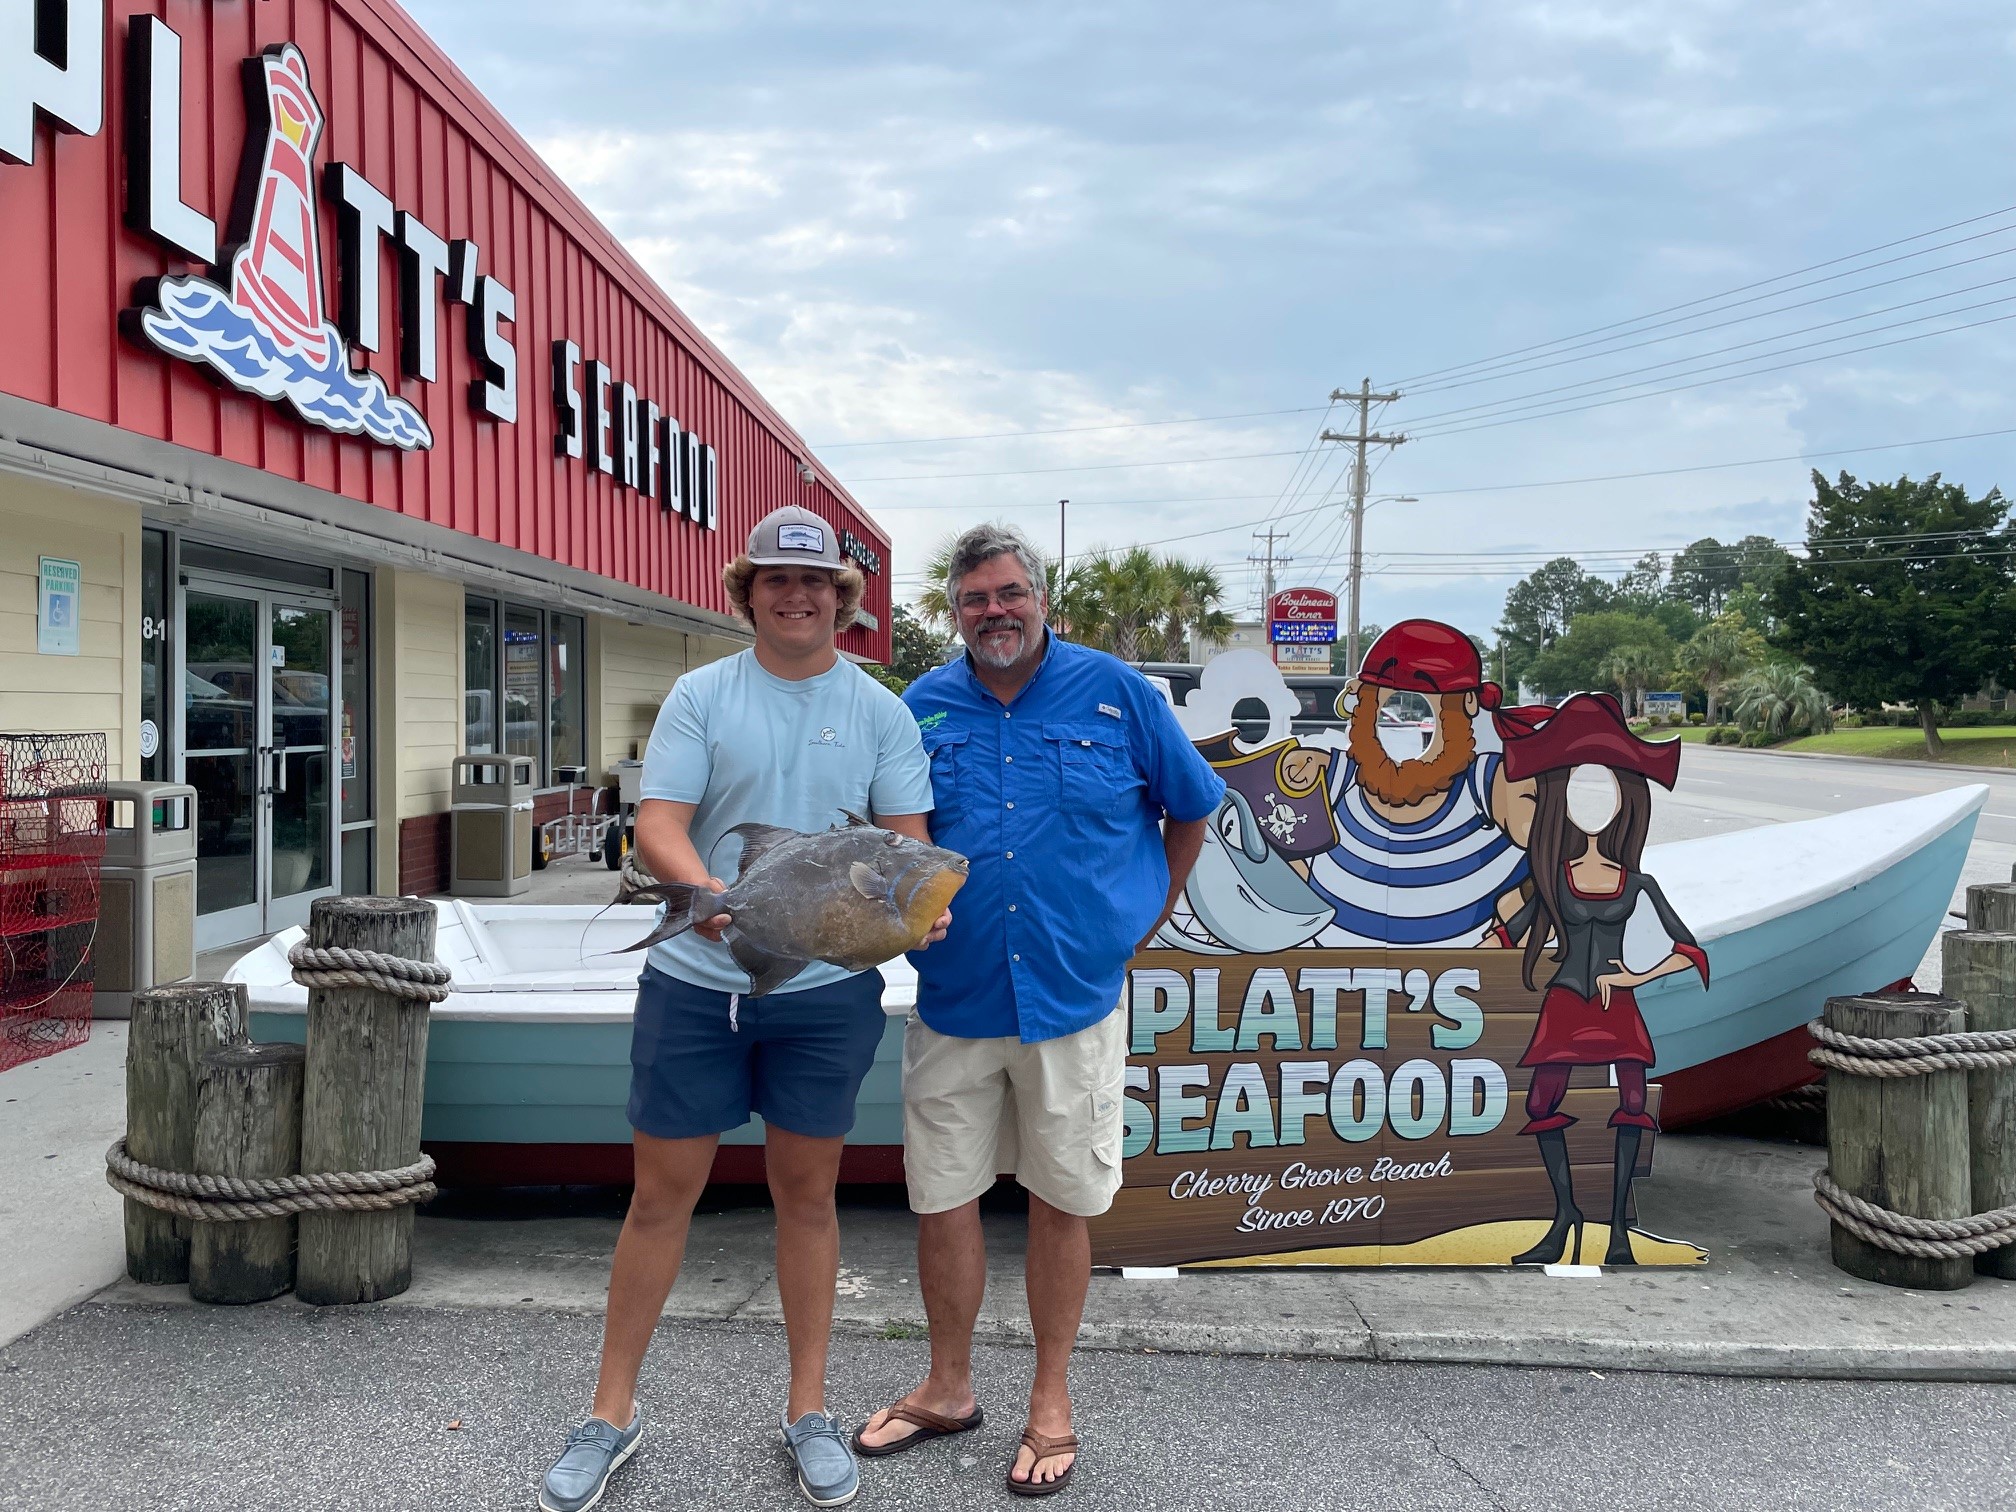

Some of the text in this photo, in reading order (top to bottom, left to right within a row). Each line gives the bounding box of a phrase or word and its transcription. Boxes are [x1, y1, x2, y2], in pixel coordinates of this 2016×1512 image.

[555, 339, 717, 531] SEAFOOD
[43, 564, 77, 580] RESERVED
[45, 579, 75, 593] PARKING
[1277, 593, 1334, 607] Boulineau's
[1287, 606, 1322, 619] Corner
[1129, 967, 1485, 1055] PLATT'S
[1121, 1058, 1509, 1160] SEAFOOD
[1169, 1150, 1454, 1206] Cherry Grove Beach
[1234, 1193, 1386, 1234] Since 1970
